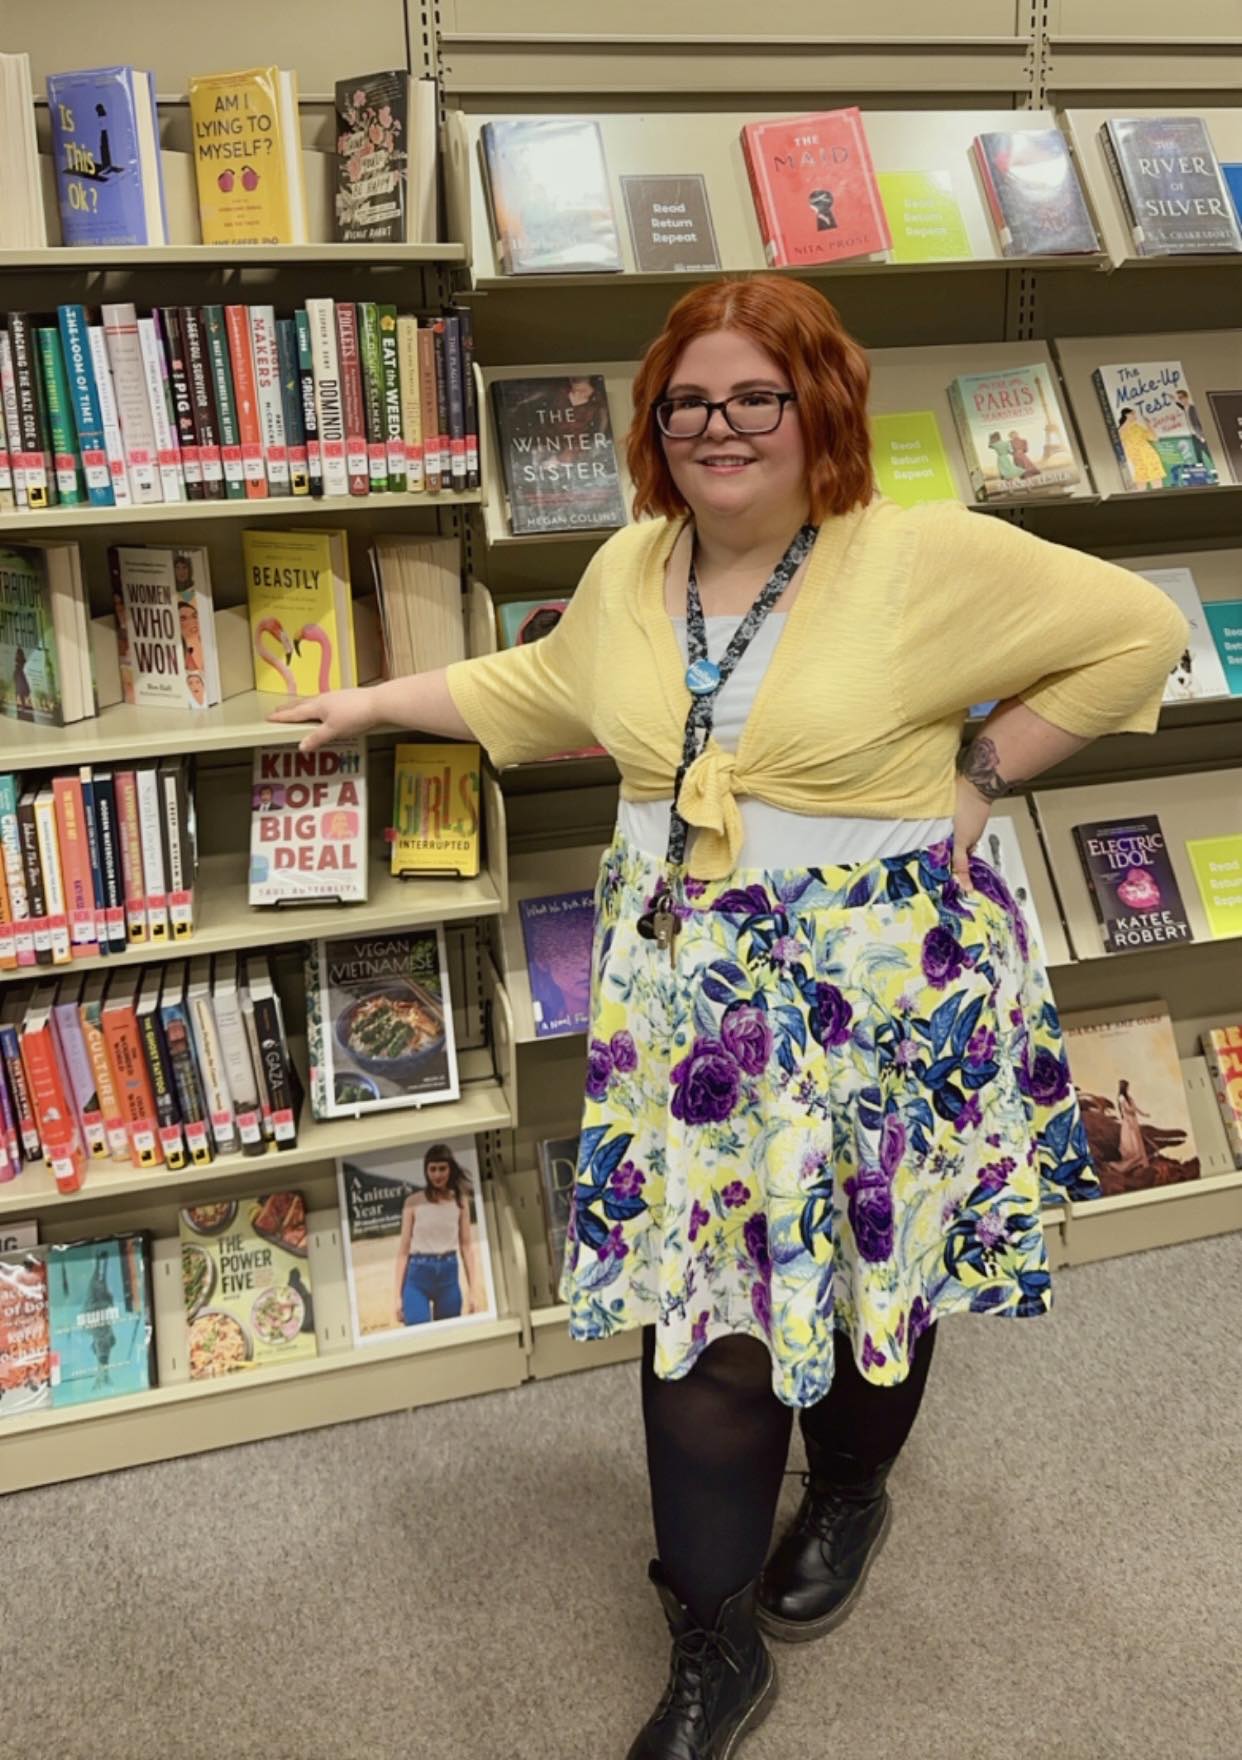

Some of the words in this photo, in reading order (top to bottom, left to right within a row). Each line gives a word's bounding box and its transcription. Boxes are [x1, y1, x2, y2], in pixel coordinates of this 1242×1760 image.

[215, 96, 239, 113] AM
[58, 104, 76, 133] Is
[196, 117, 243, 139] LYING
[249, 114, 272, 134] TO
[199, 139, 273, 162] MYSELF?
[794, 135, 819, 147] THE
[63, 142, 97, 175] This
[773, 146, 849, 172] MAID
[1138, 156, 1217, 179] RIVER
[67, 182, 98, 213] Ok?
[652, 203, 686, 214] Read
[1145, 198, 1234, 218] SILVER
[651, 217, 693, 228] Return
[652, 232, 697, 245] Repeat
[793, 244, 823, 256] NITA
[828, 236, 871, 251] PROSE
[66, 310, 77, 334] THE
[337, 310, 355, 358] POCKETS
[14, 319, 28, 368] CRACKING
[70, 336, 83, 373] LOOM
[253, 318, 272, 388] MAKERS
[382, 337, 396, 369] EAT
[18, 370, 30, 387] THE
[76, 376, 88, 391] OF
[192, 363, 208, 407] SURVIVOR
[385, 369, 397, 386] the
[1117, 367, 1140, 382] The
[174, 382, 191, 413] PIG
[973, 386, 1035, 412] PARIS
[1115, 368, 1181, 408] Make-Up
[21, 389, 33, 412] NAZI
[80, 394, 93, 424] TIME
[301, 376, 317, 431] CRUSHED
[318, 379, 343, 441] DOMINIO
[1135, 392, 1174, 416] Test
[180, 416, 193, 430] &
[371, 387, 382, 439] ELEMENT
[385, 389, 400, 443] WEEDS
[535, 408, 577, 424] THE
[23, 415, 36, 438] CODE
[512, 432, 613, 453] WINTER
[890, 440, 921, 450] Read
[523, 462, 618, 482] SISTER
[891, 454, 929, 466] Return
[893, 468, 934, 481] Repeat
[527, 515, 568, 527] MEGAN
[570, 512, 617, 525] COLLINS
[252, 565, 320, 590] BEASTLY
[127, 584, 172, 606] WOMEN
[130, 607, 175, 640] WHO
[134, 642, 179, 676] WON
[260, 750, 341, 780] KIND
[284, 782, 329, 809] OF
[336, 781, 360, 807] A
[397, 766, 479, 839] GIRLS
[100, 799, 111, 831] MODERN
[22, 822, 35, 850] Behind
[259, 814, 316, 843] BIG
[103, 832, 115, 879] WATERCOLOR
[399, 839, 471, 851] INTERRUPTED
[1087, 832, 1165, 857] ELECTRIC
[27, 851, 37, 865] The
[273, 844, 358, 871] DEAL
[1106, 850, 1155, 869] IDOL
[1208, 860, 1240, 872] Read
[1115, 910, 1174, 930] KATEE
[1114, 924, 1188, 947] ROBERT
[354, 940, 410, 958] VEGAN
[331, 951, 434, 981] VIETNAMESE
[145, 1032, 160, 1062] GHOST
[87, 1030, 115, 1106] CULTURE
[263, 1050, 283, 1091] GAZA
[152, 1065, 167, 1100] TATTOO
[351, 1176, 362, 1190] A
[351, 1182, 413, 1204] Knitter's
[352, 1204, 384, 1219] Year
[217, 1232, 244, 1254] THE
[220, 1250, 273, 1275] POWER
[221, 1272, 255, 1295] FIVE
[76, 1305, 120, 1326] swim
